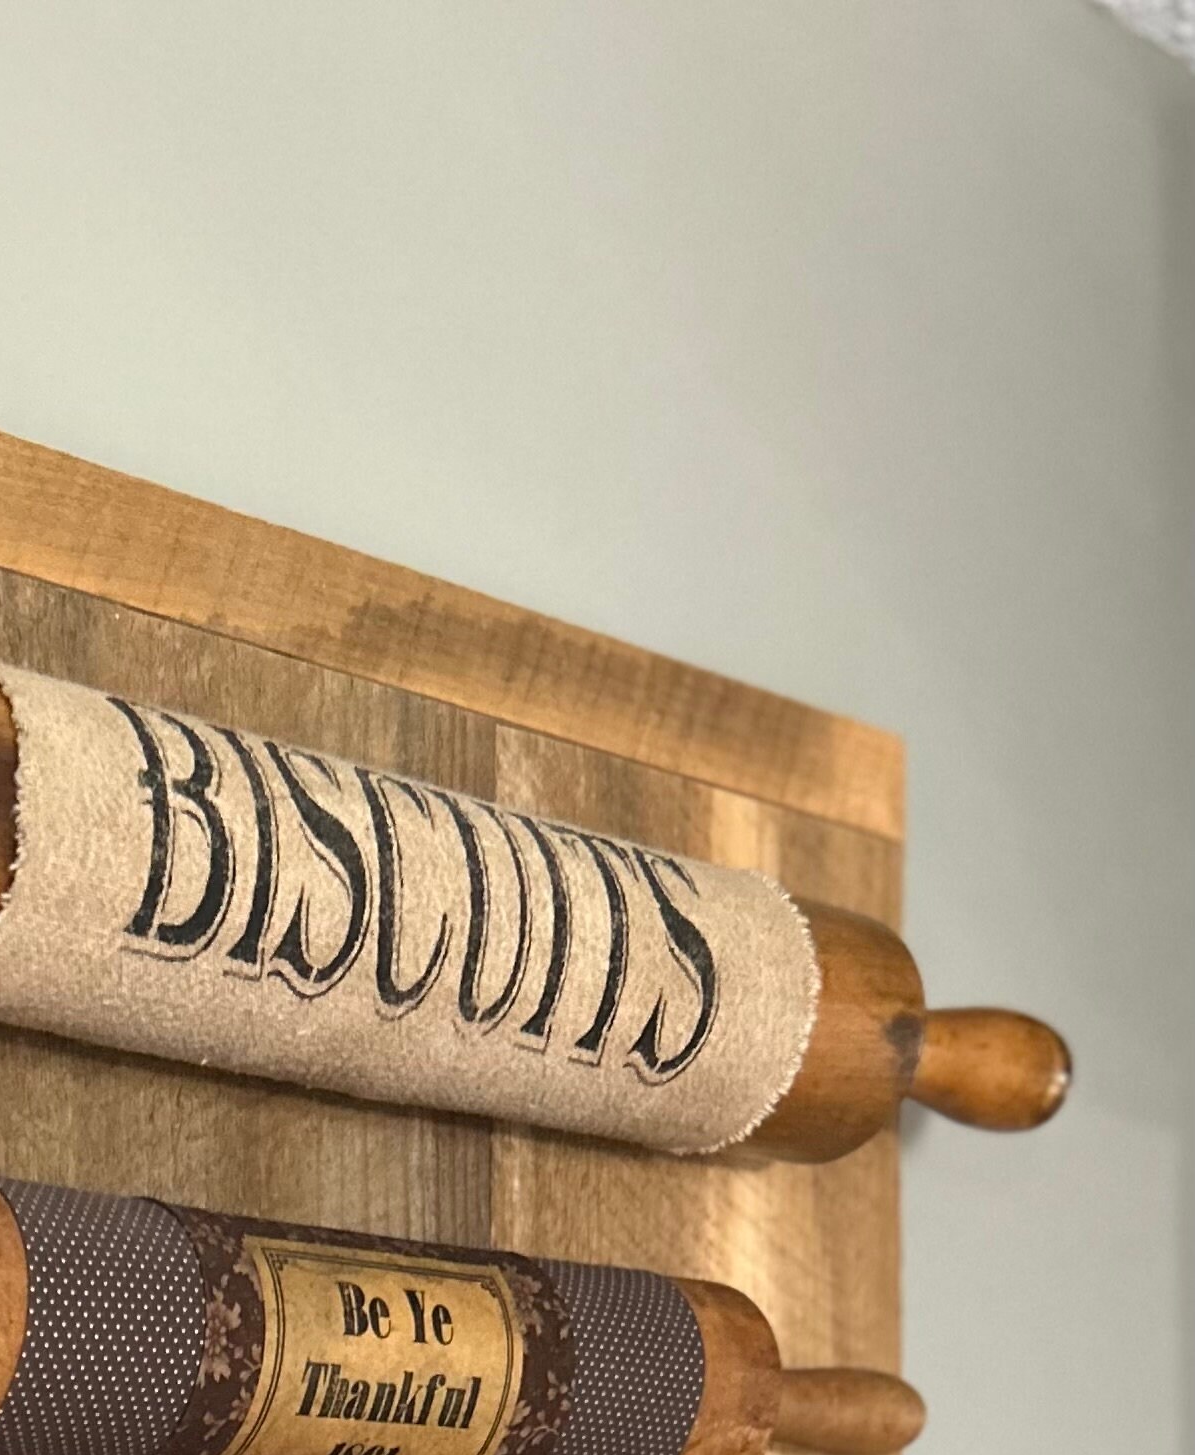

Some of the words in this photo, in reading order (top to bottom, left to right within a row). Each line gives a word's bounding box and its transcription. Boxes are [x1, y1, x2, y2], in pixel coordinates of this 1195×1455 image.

[106, 696, 720, 1086] BISCUITS
[338, 1281, 392, 1339] Be
[403, 1288, 454, 1345] Ye
[295, 1357, 482, 1429] Thankful
